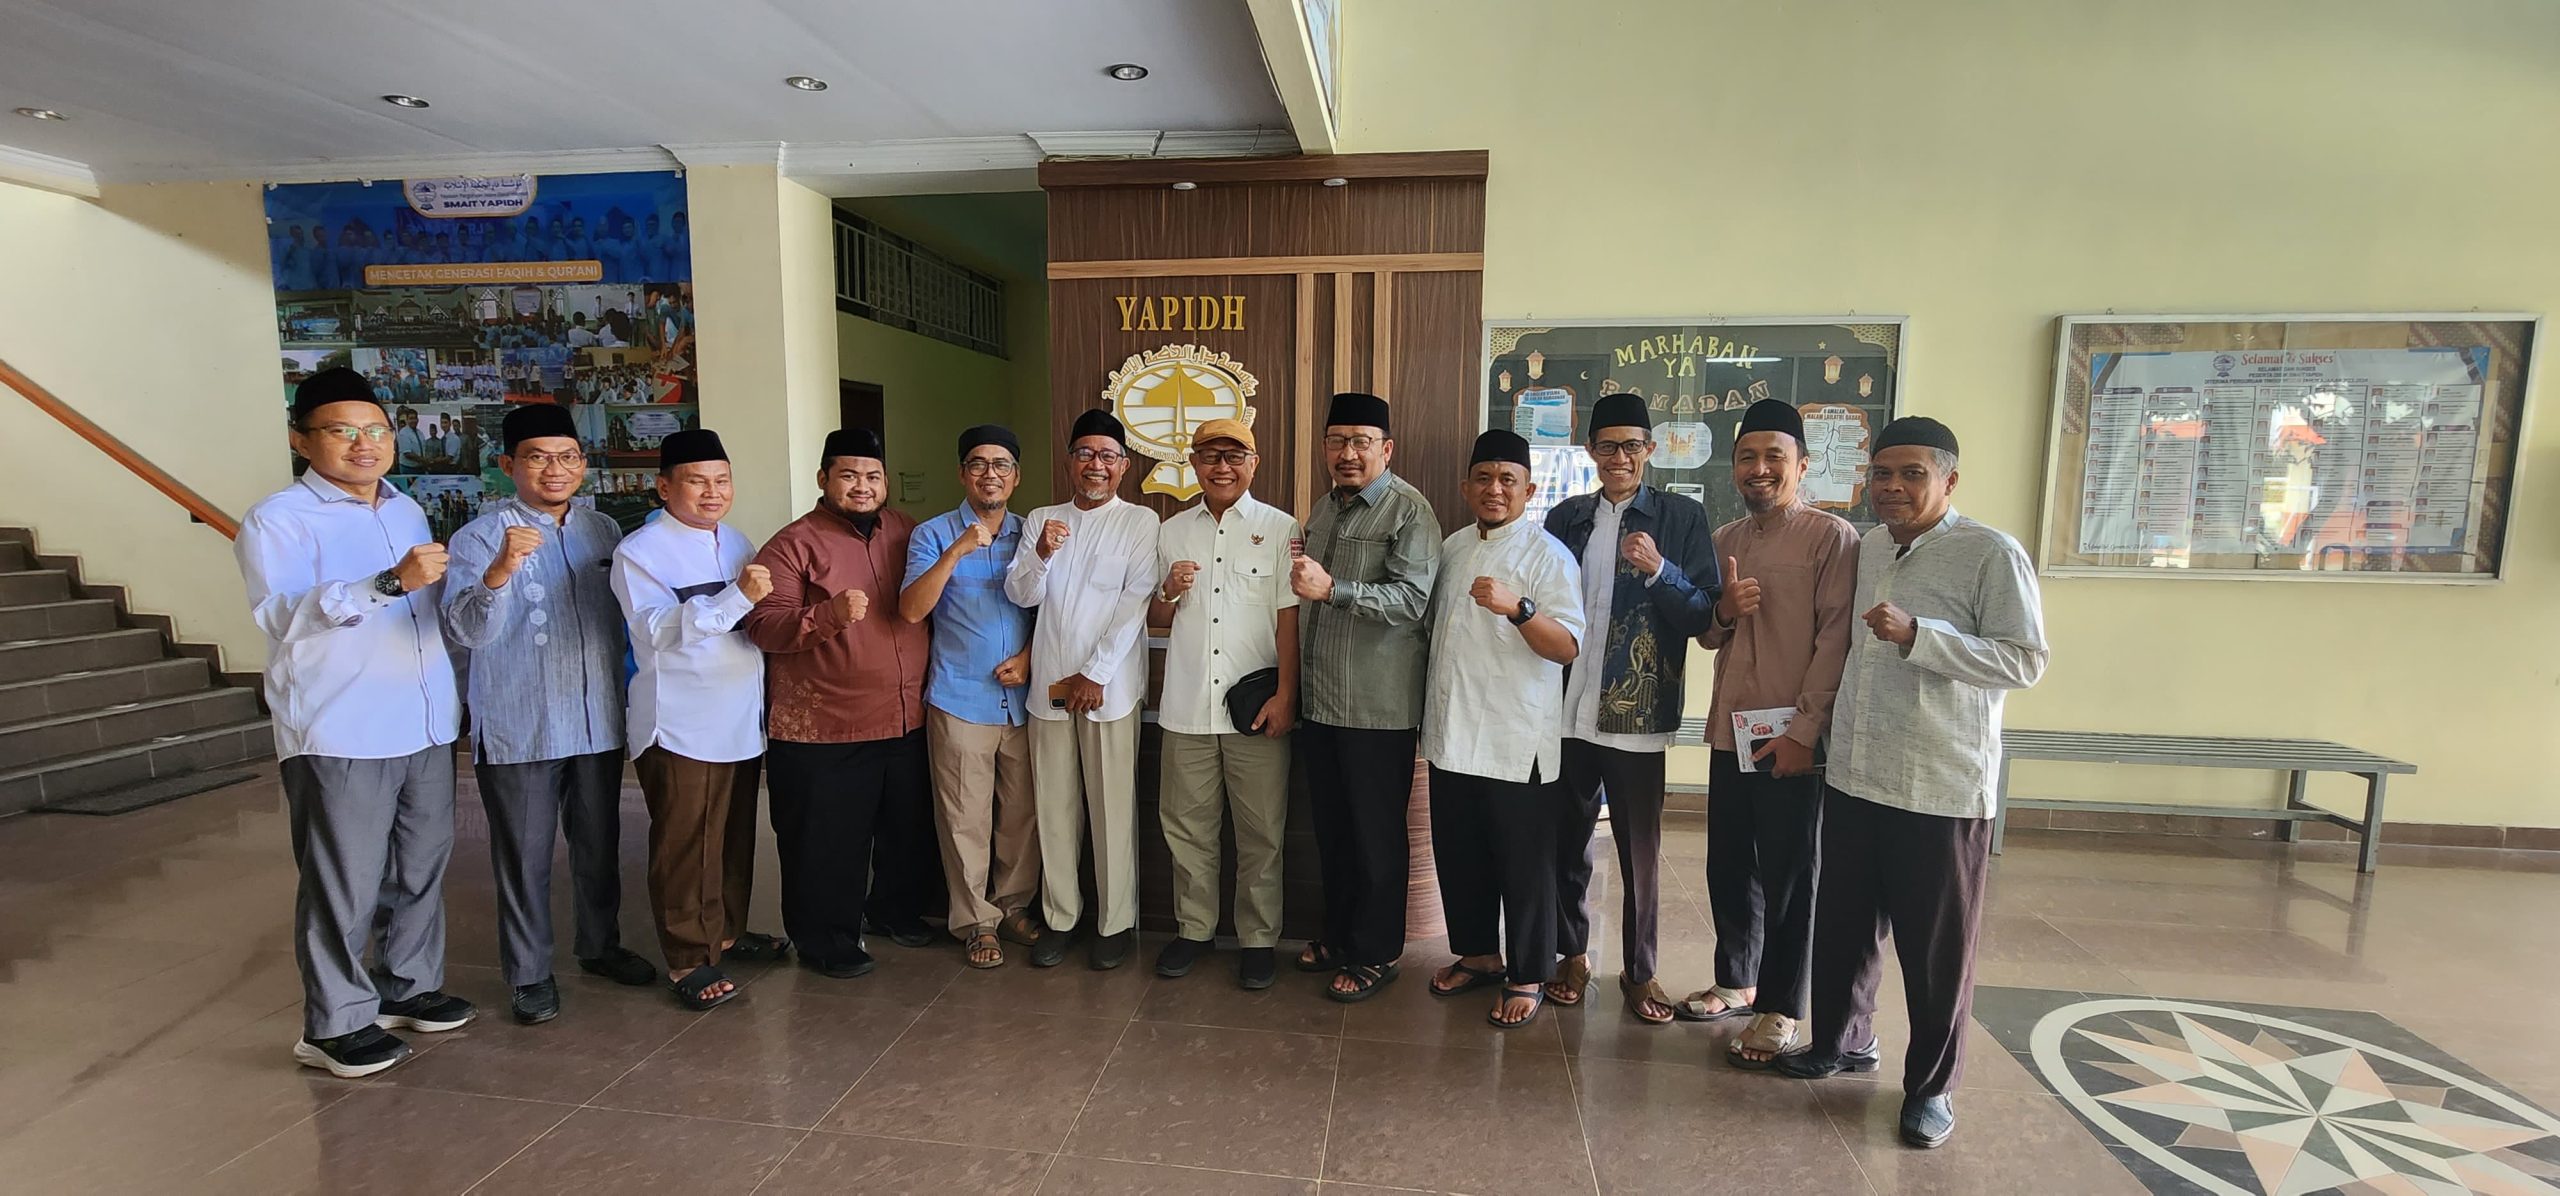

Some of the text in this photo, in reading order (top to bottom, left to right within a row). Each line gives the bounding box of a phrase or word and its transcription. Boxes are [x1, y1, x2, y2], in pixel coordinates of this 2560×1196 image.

[443, 199, 523, 208] SMAIT YAPIDH
[369, 265, 598, 281] MENCETAK GENERASI FAQIH & QUR'ANI
[1115, 295, 1246, 331] YAPIDH
[1614, 334, 1759, 369] MARHABAN
[2240, 353, 2284, 366] Selamat
[2298, 352, 2334, 365] Sukses
[1663, 356, 1697, 378] YA
